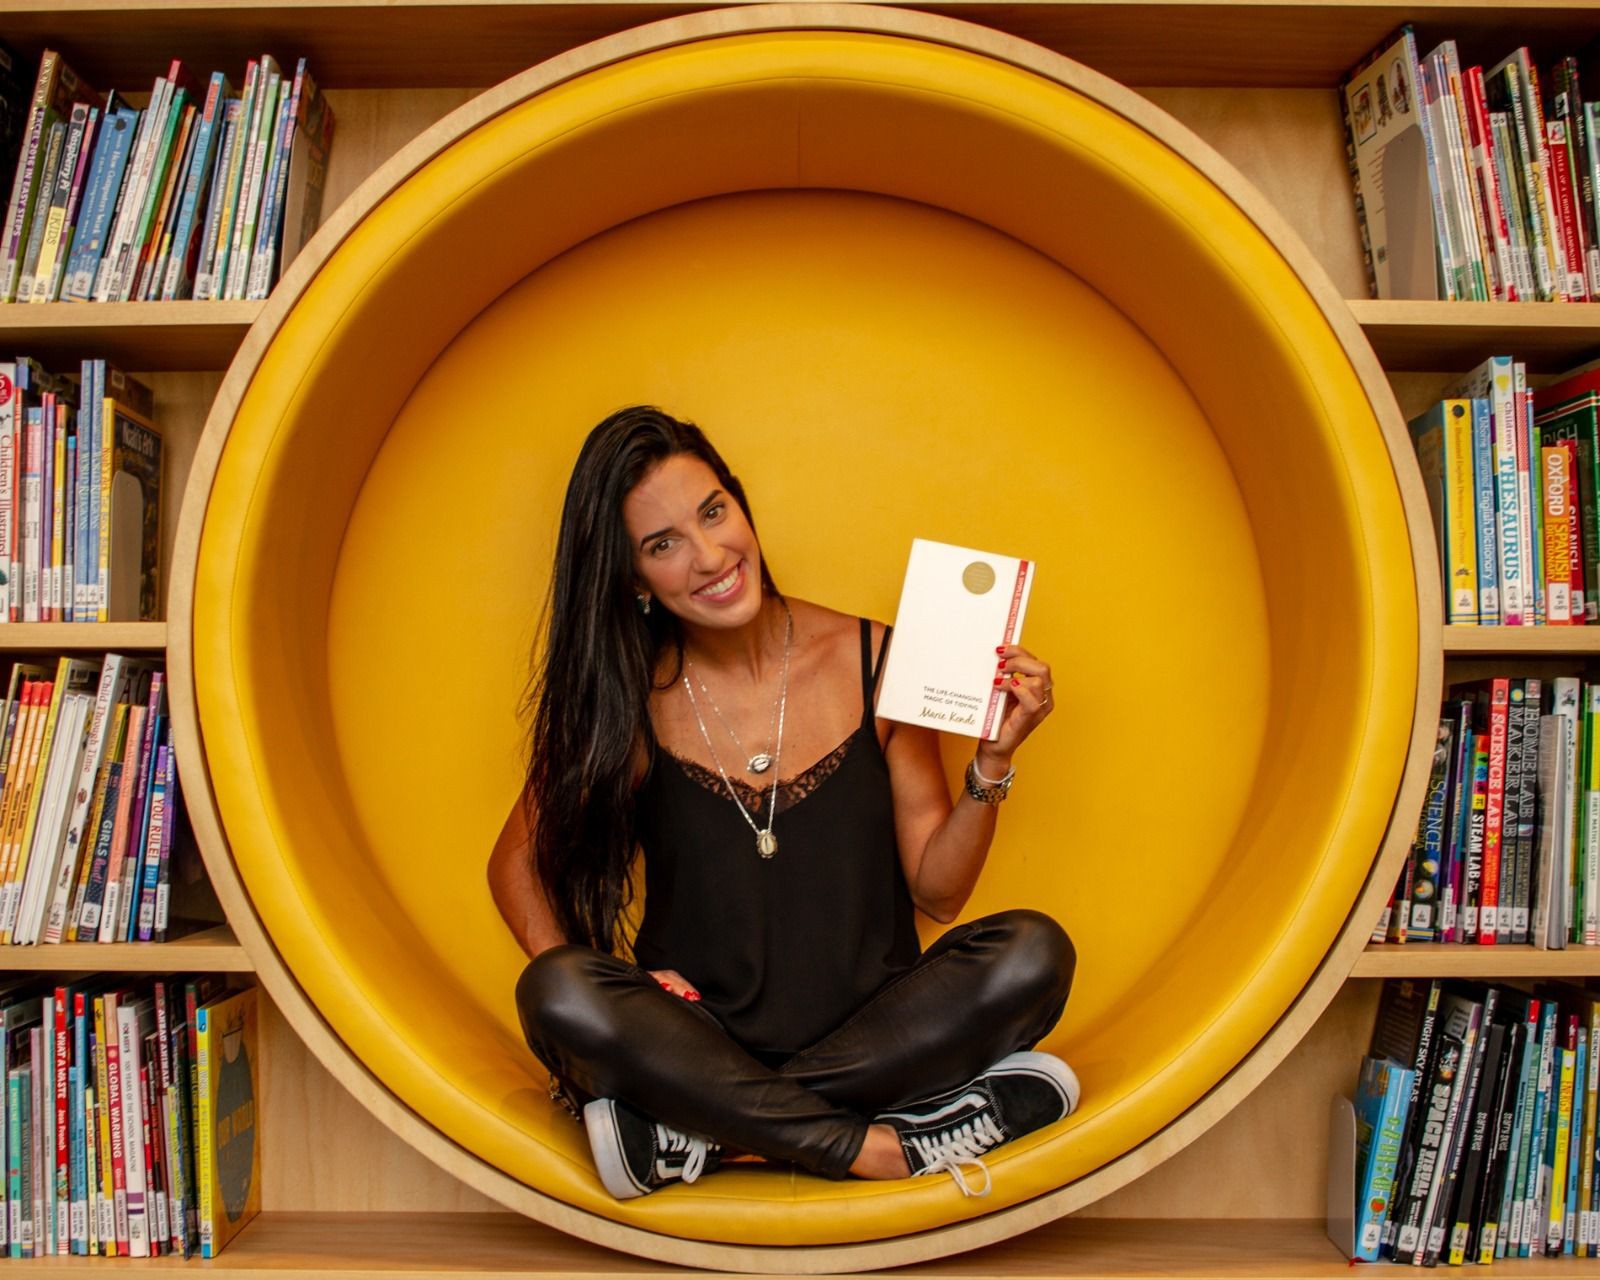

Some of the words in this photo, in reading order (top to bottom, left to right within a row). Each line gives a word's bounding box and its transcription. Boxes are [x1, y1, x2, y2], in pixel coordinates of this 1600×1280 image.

[32, 111, 44, 141] EXCEL
[60, 127, 82, 180] Raspberry
[1556, 150, 1566, 172] TALES
[24, 167, 33, 177] IN
[1559, 174, 1568, 184] OF
[19, 179, 31, 205] EASY
[1561, 193, 1572, 223] CHINESE
[13, 206, 25, 237] STEPS
[1565, 225, 1578, 273] GRANDMOTHE
[1478, 415, 1489, 448] Usborne
[1504, 401, 1514, 451] Children's
[0, 434, 11, 494] Children's
[1479, 450, 1490, 488] Illustrated
[1547, 453, 1564, 515] OXFORD
[1479, 490, 1493, 525] English
[1499, 455, 1520, 581] THESAURUS
[1480, 526, 1496, 580] Dictionary
[1545, 524, 1555, 579] DICTIONARY
[1552, 524, 1569, 580] SPANISH
[104, 663, 115, 673] A
[98, 674, 113, 703] Child
[88, 705, 105, 746] Through
[918, 707, 946, 720] Marie
[1487, 713, 1504, 789] SCIENCE
[1504, 706, 1523, 789] MAKER
[1521, 707, 1539, 772] HOME
[83, 748, 96, 773] Time
[151, 797, 164, 821] YOU
[1485, 793, 1500, 827] LAB
[1519, 773, 1536, 817] LAB
[1422, 779, 1447, 852] SCIENCE
[1502, 793, 1519, 837] LAB
[96, 818, 113, 857] GIRLS
[148, 824, 161, 859] RULE!
[1470, 814, 1484, 852] STEAM
[1468, 855, 1481, 878] LAB
[56, 1031, 65, 1057] WHAT
[121, 1022, 129, 1034] FOR
[122, 1035, 130, 1053] KEEPS
[1419, 1015, 1434, 1048] NIGHT
[1415, 1047, 1427, 1067] SKY
[1541, 1030, 1551, 1060] SCIENCE
[57, 1058, 65, 1067] A
[160, 1043, 169, 1088] ANIMALS
[57, 1068, 66, 1099] WASTE
[109, 1062, 119, 1104] GLOBAL
[126, 1115, 134, 1139] SCHOOL
[1422, 1082, 1451, 1148] SPACE
[1473, 1111, 1487, 1134] Starry
[1500, 1111, 1513, 1134] Starry
[110, 1107, 122, 1158] WARMING
[1470, 1133, 1483, 1151] Skies
[1498, 1134, 1510, 1151] Skies
[127, 1141, 137, 1172] MAGAZINE
[1415, 1148, 1436, 1198] VISUAL
[1526, 1169, 1536, 1197] FORCES
